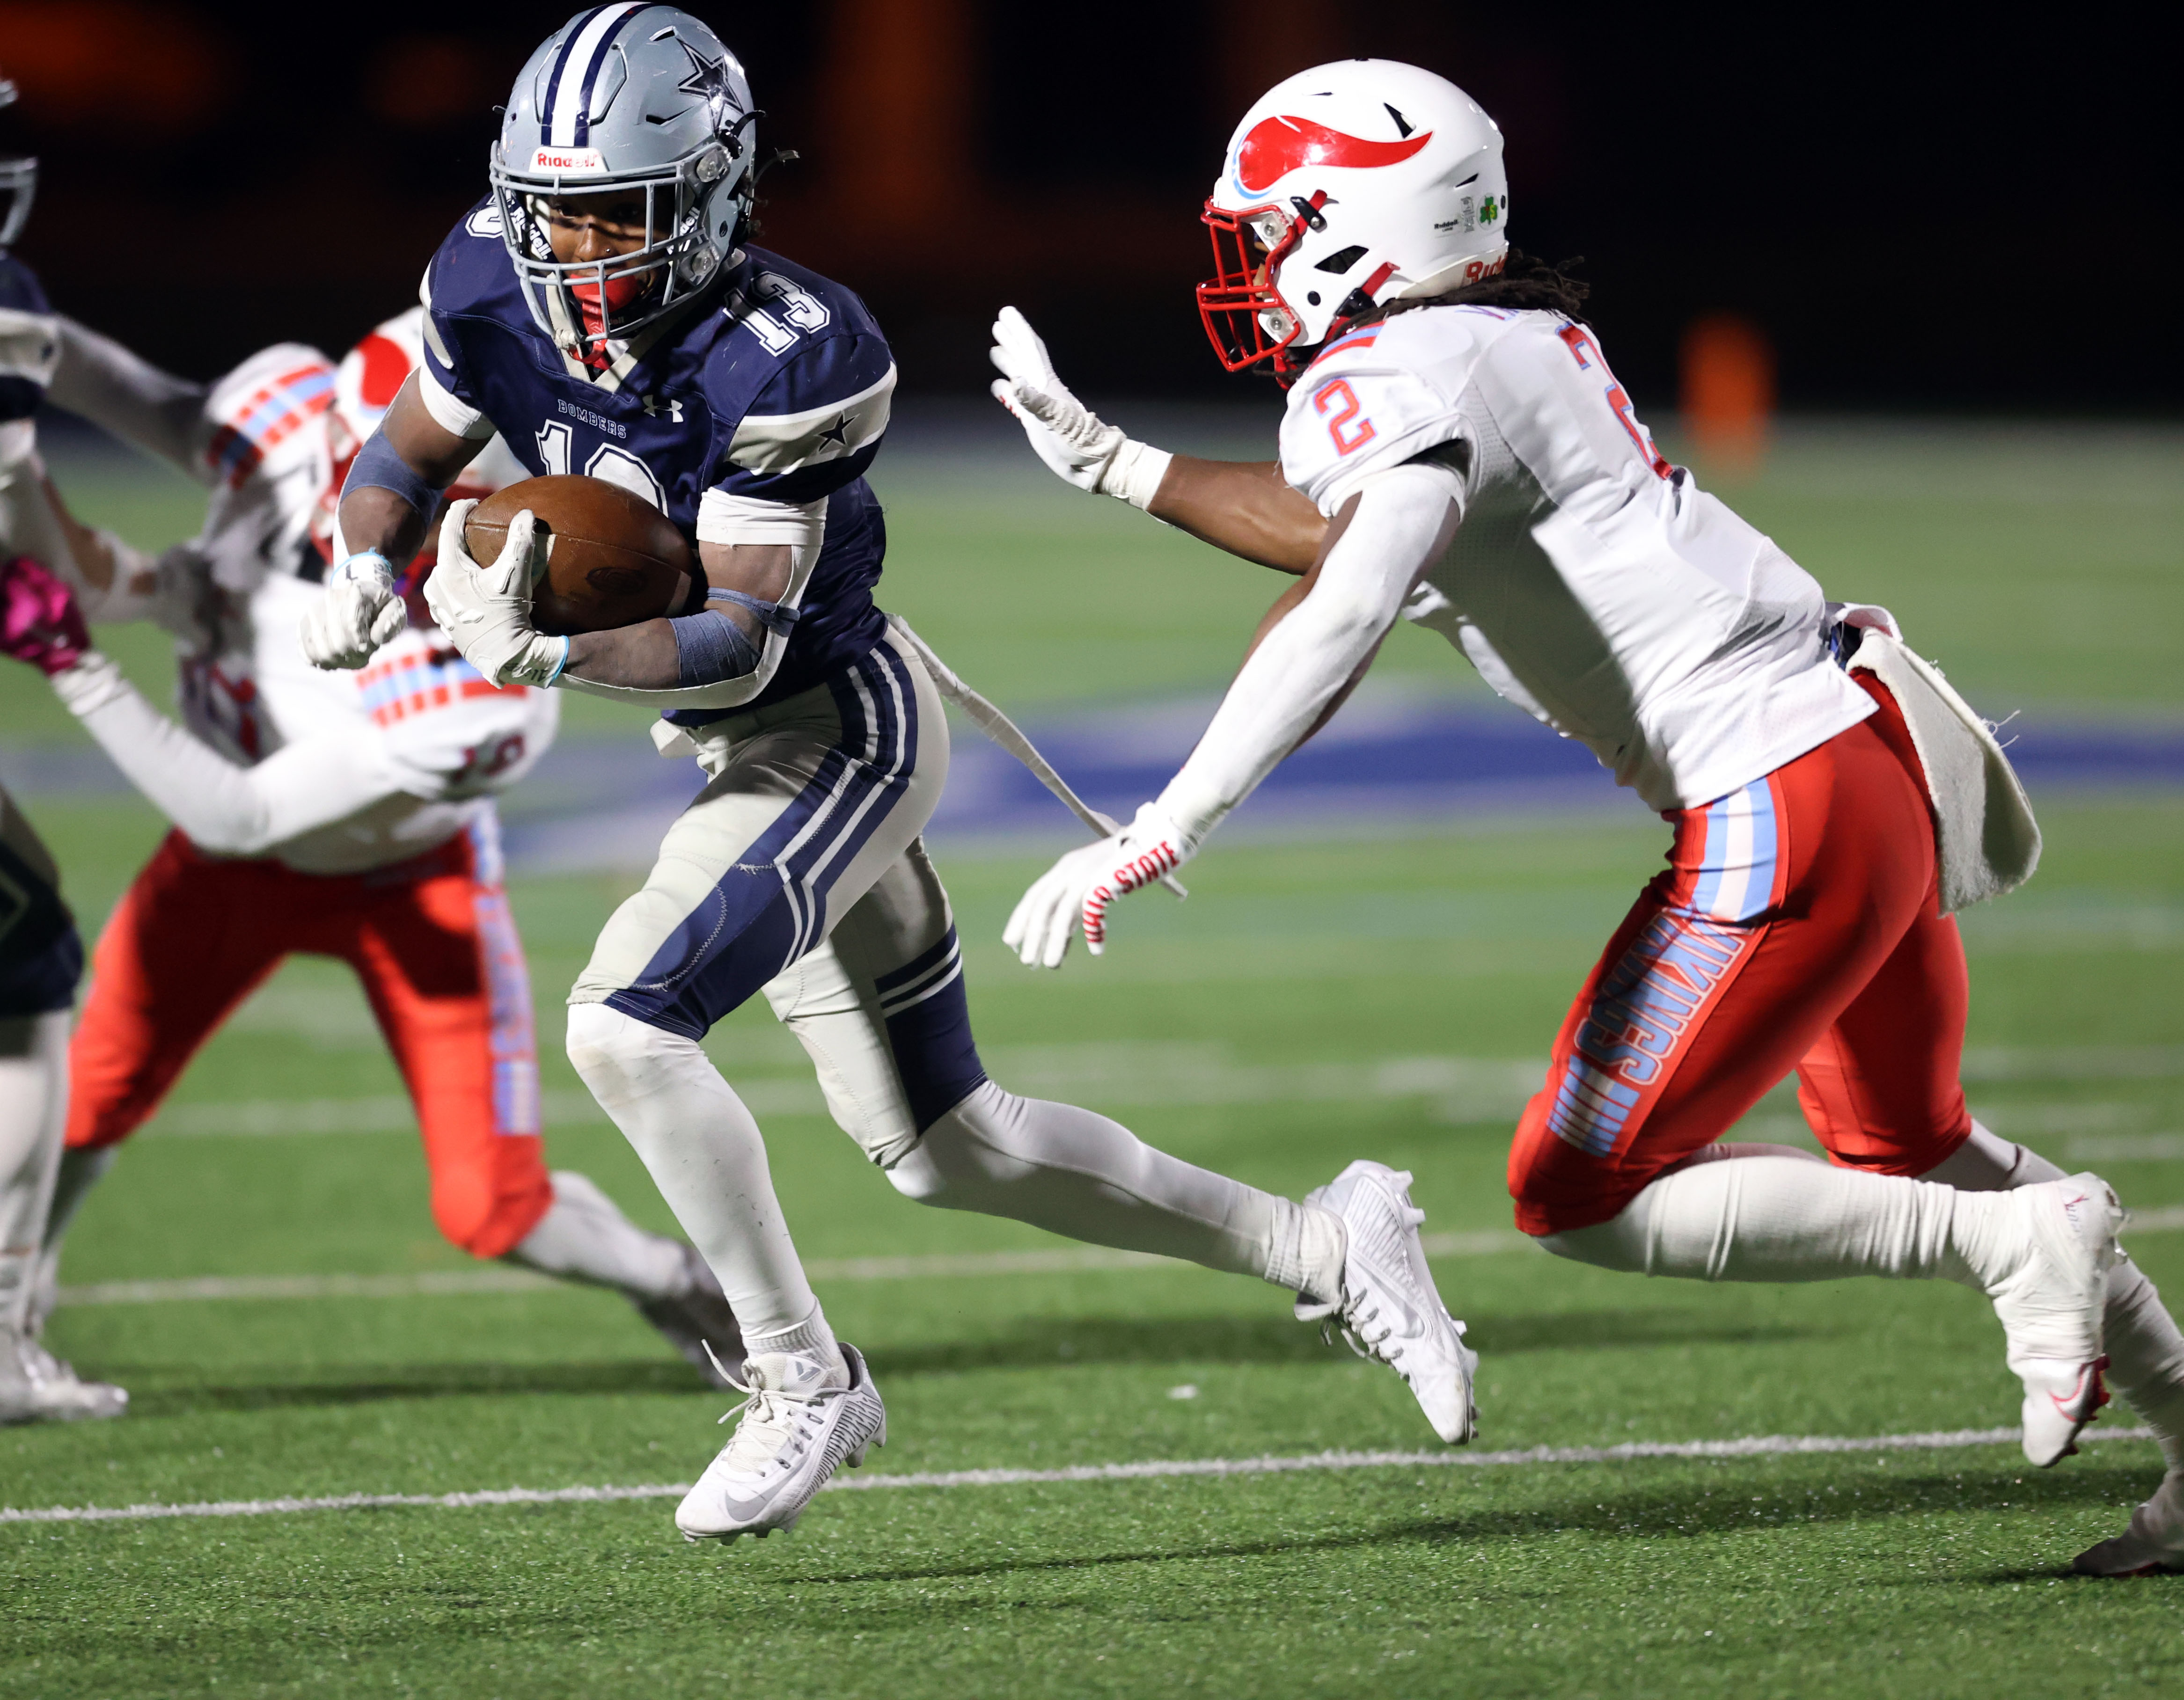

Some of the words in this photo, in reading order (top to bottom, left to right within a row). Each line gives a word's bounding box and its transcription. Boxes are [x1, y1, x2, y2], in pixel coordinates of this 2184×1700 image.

[723, 270, 830, 358] 13
[557, 399, 627, 439] BOMBERS
[1312, 376, 1377, 457] 2
[1114, 840, 1180, 894] STATE
[1574, 907, 1755, 1085] VIKINGS
